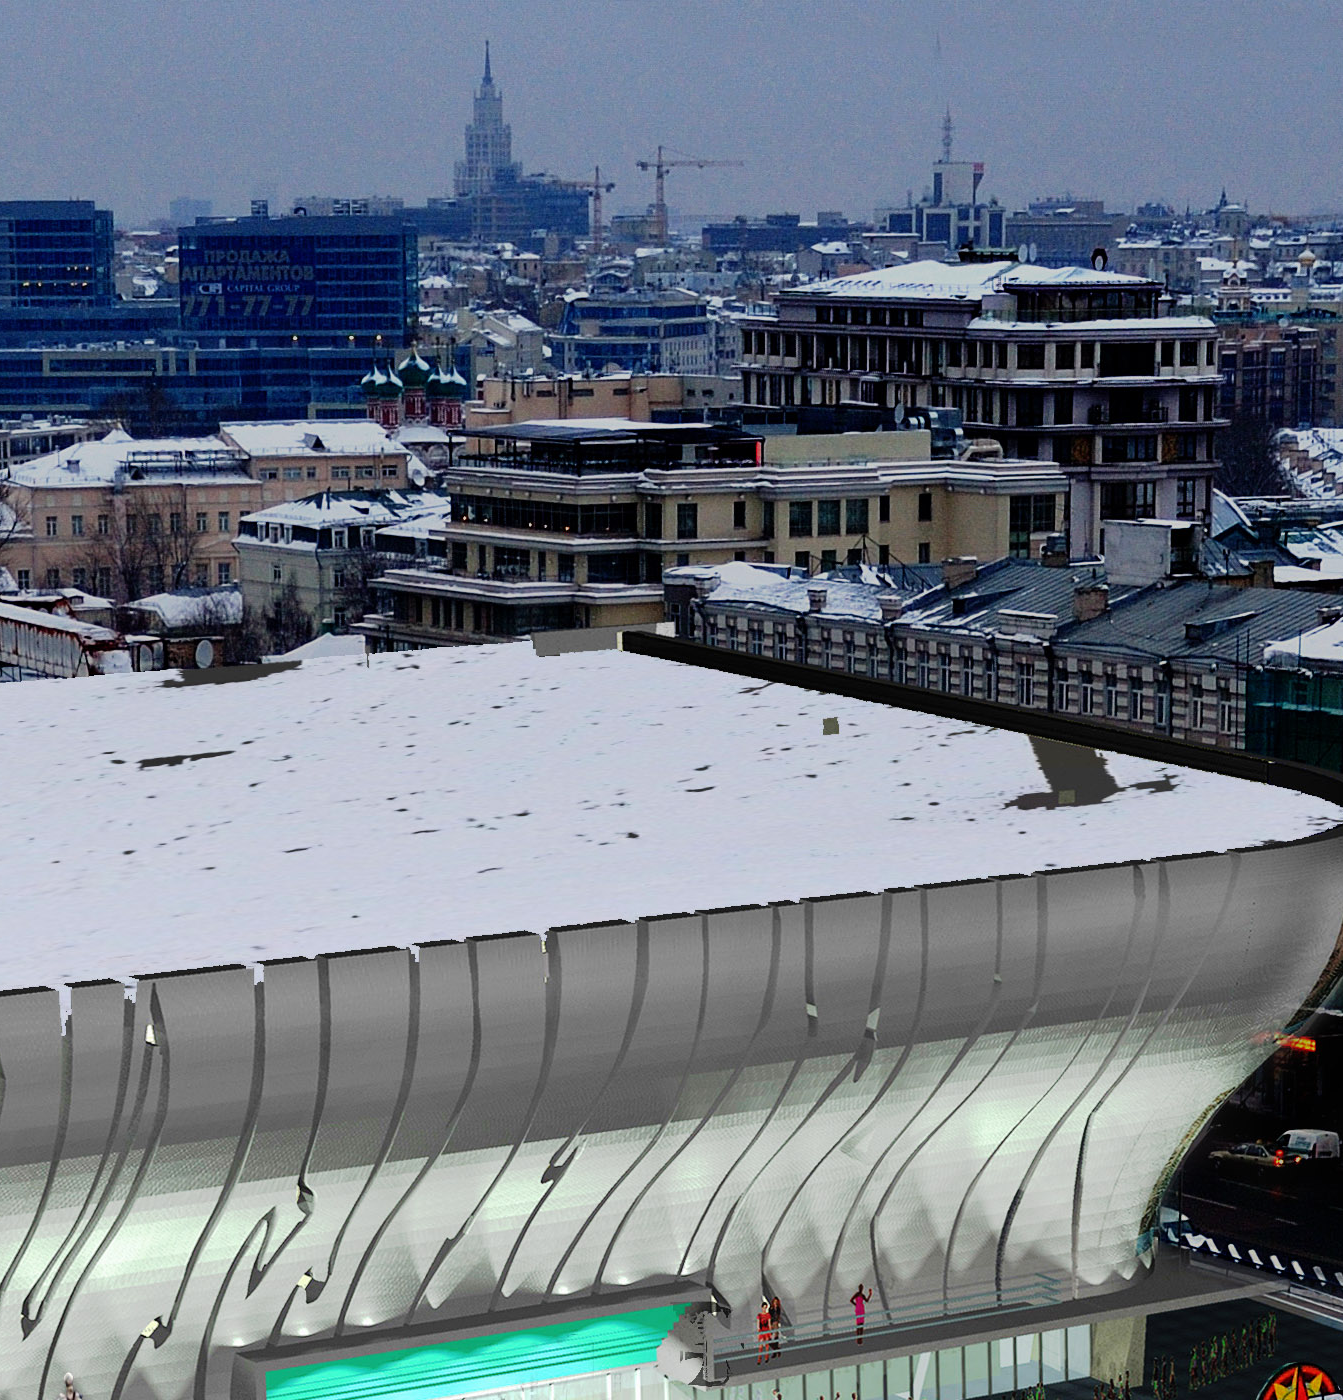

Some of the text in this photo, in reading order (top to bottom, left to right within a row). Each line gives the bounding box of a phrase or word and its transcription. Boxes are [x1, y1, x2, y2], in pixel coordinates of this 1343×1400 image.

[204, 249, 290, 264] ПРОДАЖА
[181, 264, 314, 281] АПАРТАМЕНТОВ
[227, 284, 264, 292] CAPITAL
[267, 284, 300, 293] GROUP
[182, 294, 314, 316] 771-77-77
